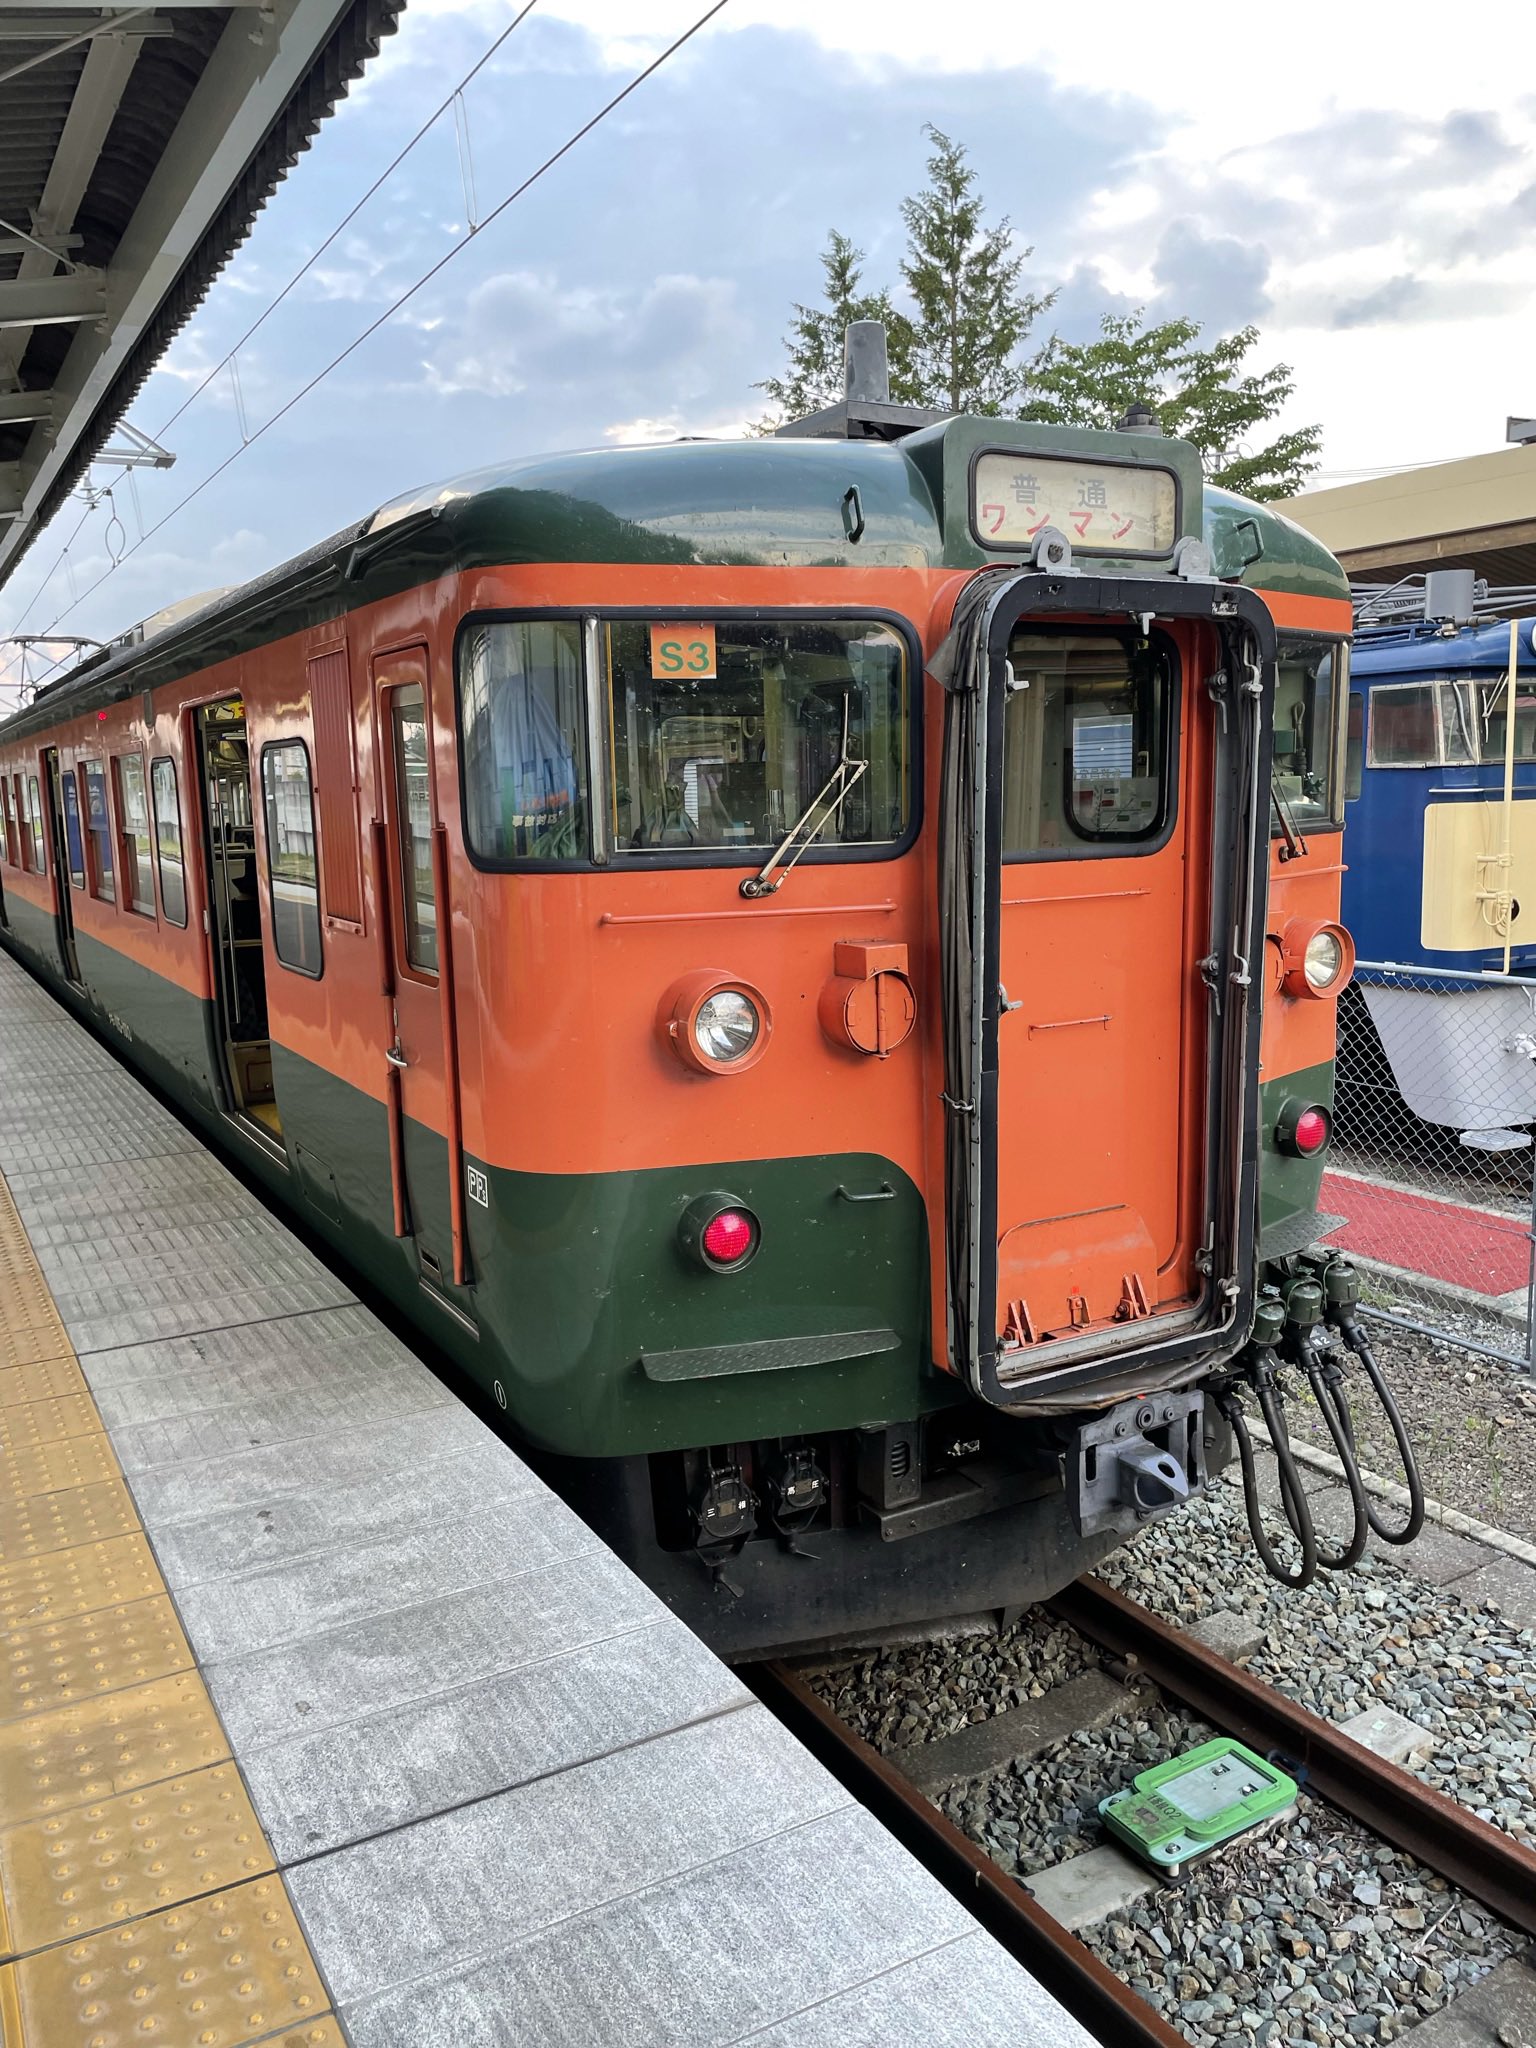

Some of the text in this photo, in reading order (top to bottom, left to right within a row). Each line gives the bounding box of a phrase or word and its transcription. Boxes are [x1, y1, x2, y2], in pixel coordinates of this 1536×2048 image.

[1010, 473, 1108, 509] 普通
[982, 504, 1134, 540] ワンマン
[660, 642, 709, 672] S3
